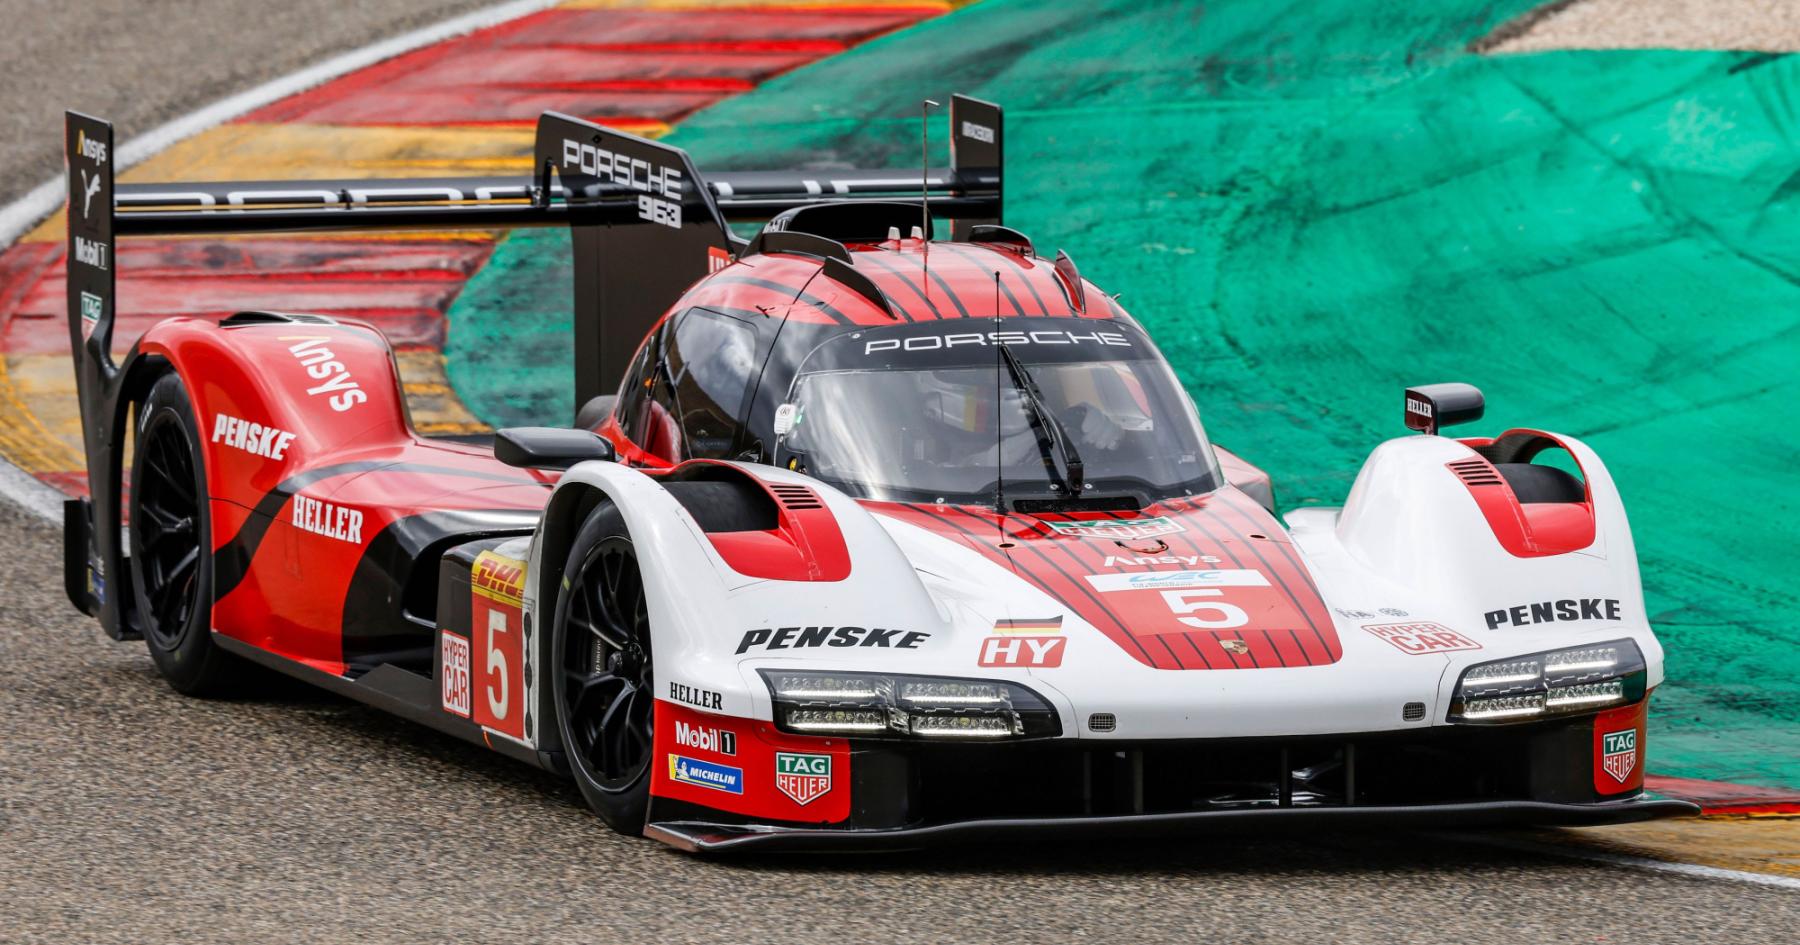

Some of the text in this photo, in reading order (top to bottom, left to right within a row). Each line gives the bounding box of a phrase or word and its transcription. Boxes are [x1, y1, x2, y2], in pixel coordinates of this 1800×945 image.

[77, 130, 106, 166] Ansys
[563, 139, 681, 201] PORSCHE
[638, 195, 682, 229] 963
[75, 236, 99, 267] Mobil
[864, 331, 1132, 355] PORSCHE
[277, 335, 367, 412] Ansys
[1407, 398, 1432, 418] HELLER
[212, 414, 296, 461] PENSKE
[292, 494, 363, 544] HELLER
[1104, 555, 1221, 567] Ansys
[474, 558, 523, 598] DHL
[1159, 589, 1249, 628] 5
[1484, 599, 1622, 630] PENSKE
[734, 625, 932, 655] PENSKE
[1370, 624, 1443, 637] HYPER
[1391, 632, 1472, 651] CAR
[443, 637, 468, 669] HYPER
[487, 608, 508, 720] 5
[983, 639, 1059, 664] HY
[444, 667, 468, 709] CAR
[670, 682, 723, 710] HELLER
[675, 720, 719, 752] Mobil
[1606, 733, 1634, 752] TAG
[689, 766, 736, 785] MICHELIN
[780, 757, 826, 774] TAG
[1606, 753, 1634, 778] HEUER
[778, 776, 828, 801] HEUER
